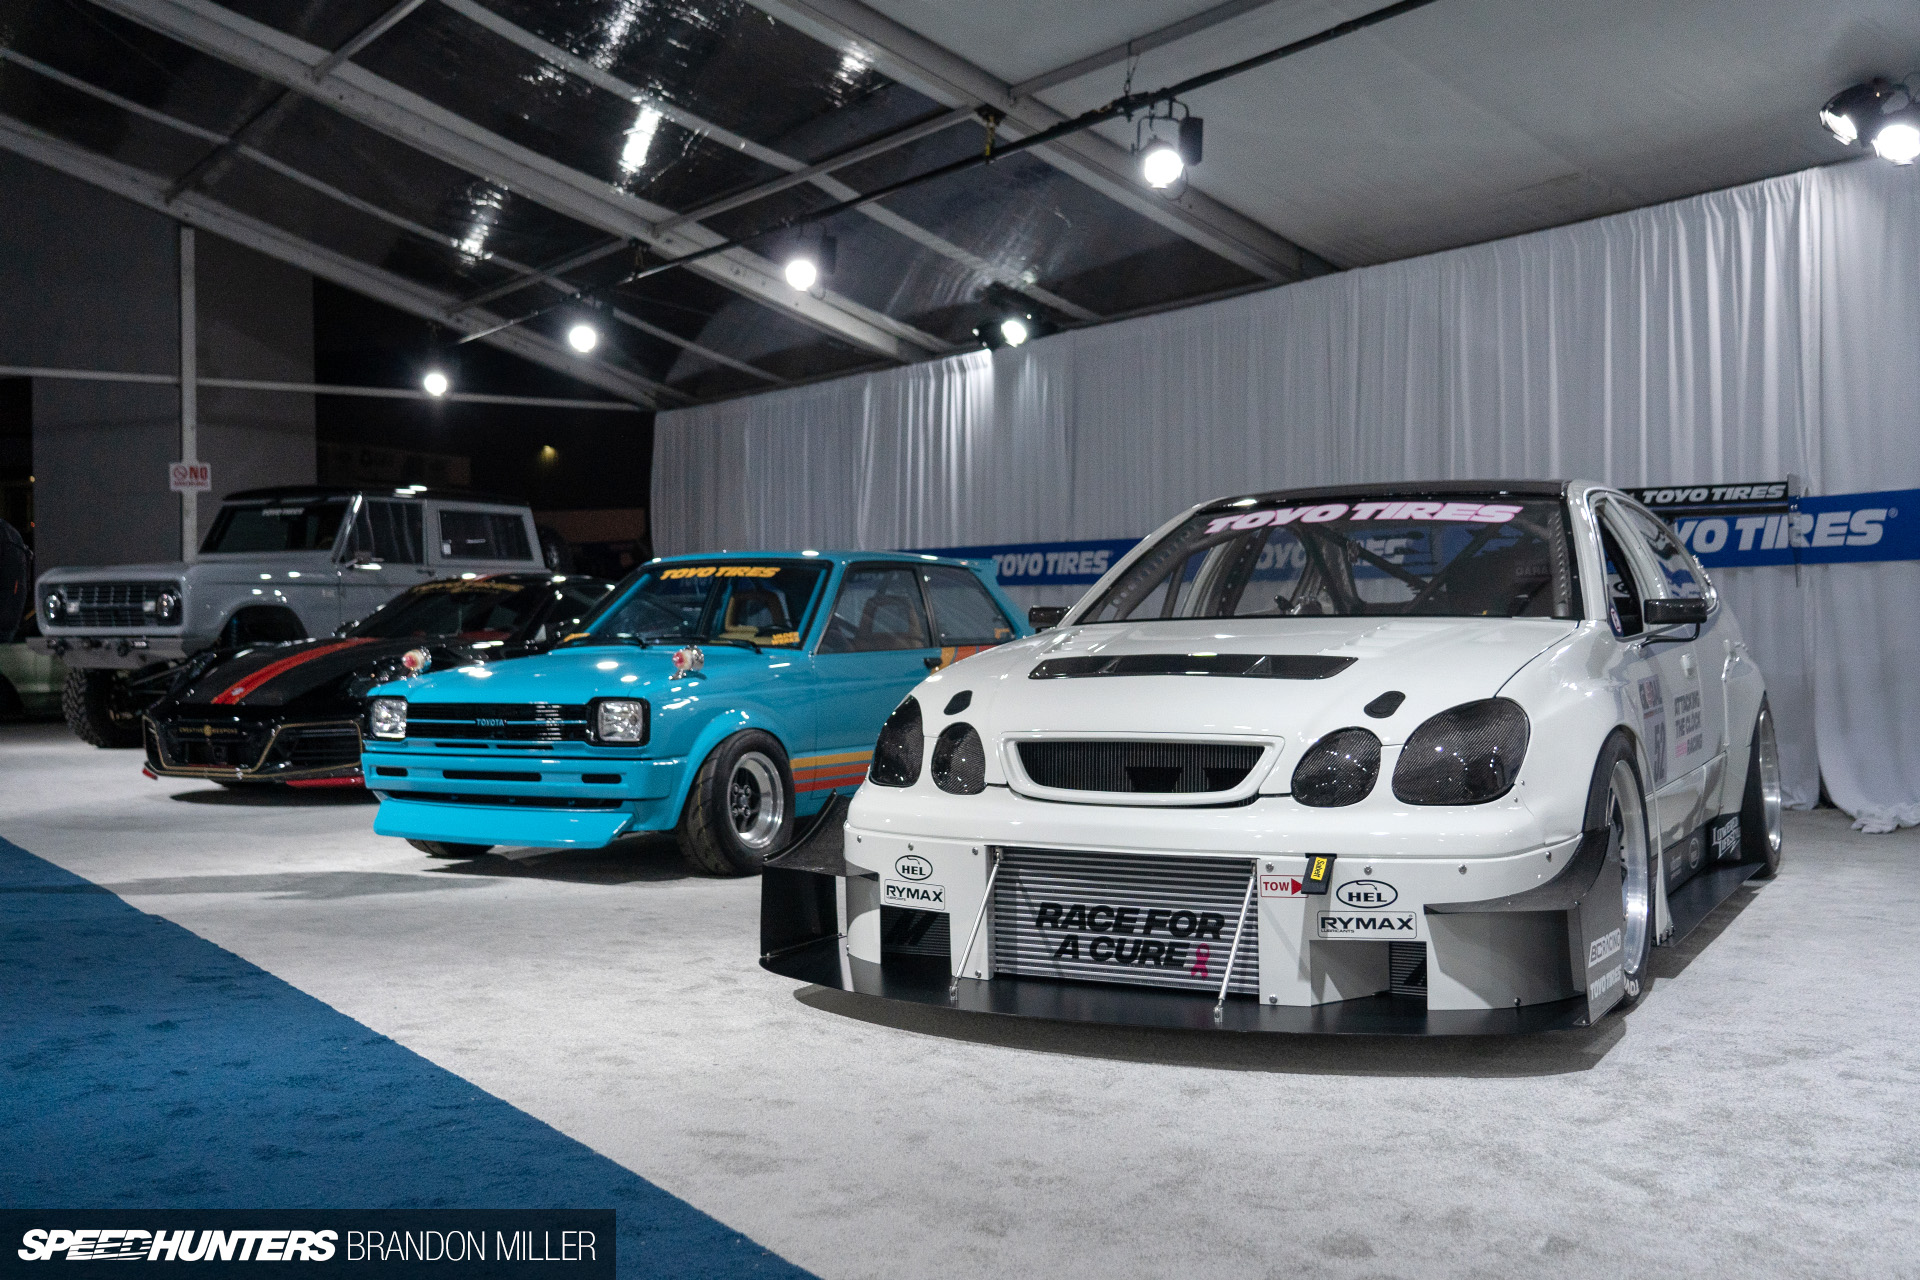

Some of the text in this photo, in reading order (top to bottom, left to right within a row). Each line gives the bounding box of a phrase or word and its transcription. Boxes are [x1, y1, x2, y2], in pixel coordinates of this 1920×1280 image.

[189, 466, 208, 480] NO
[1642, 485, 1787, 504] TOYO TIRES
[1203, 502, 1524, 534] TOYO TIRES
[1674, 508, 1888, 554] YO TIRES
[993, 551, 1111, 578] TOYO TIRES
[660, 566, 781, 581] TOYO TIRES
[476, 718, 505, 727] TOYOTA
[901, 864, 926, 876] HEL
[886, 884, 943, 903] RYMAX
[1263, 880, 1291, 892] TOW
[1347, 892, 1387, 903] HEL
[1035, 901, 1226, 940] RACE FOR
[1320, 916, 1414, 931] RYMAX
[1053, 934, 1190, 968] A CURE
